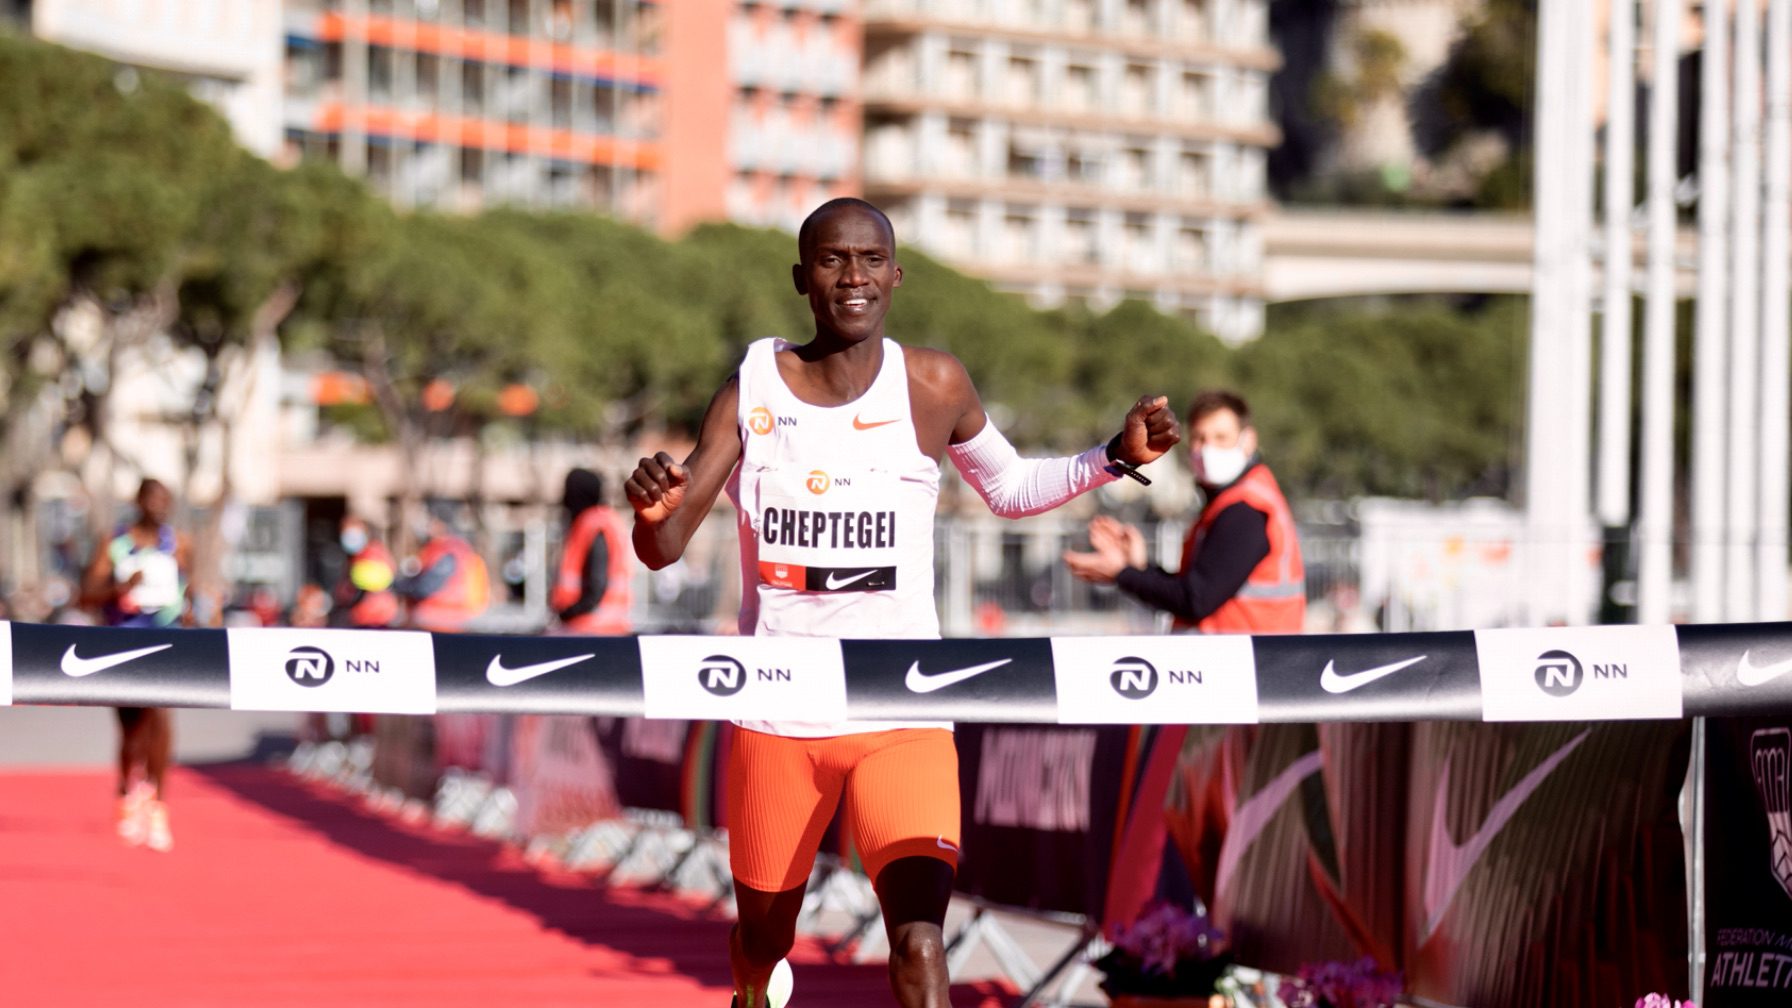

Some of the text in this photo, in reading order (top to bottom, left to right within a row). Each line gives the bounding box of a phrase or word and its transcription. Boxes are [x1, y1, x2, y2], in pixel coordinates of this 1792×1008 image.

[777, 416, 797, 427] NN
[834, 477, 851, 487] NN
[763, 506, 895, 549] CHEPTEGEI
[346, 659, 380, 673] NN
[1592, 663, 1627, 679] NN
[757, 668, 791, 682] NN
[1168, 670, 1202, 684] NN
